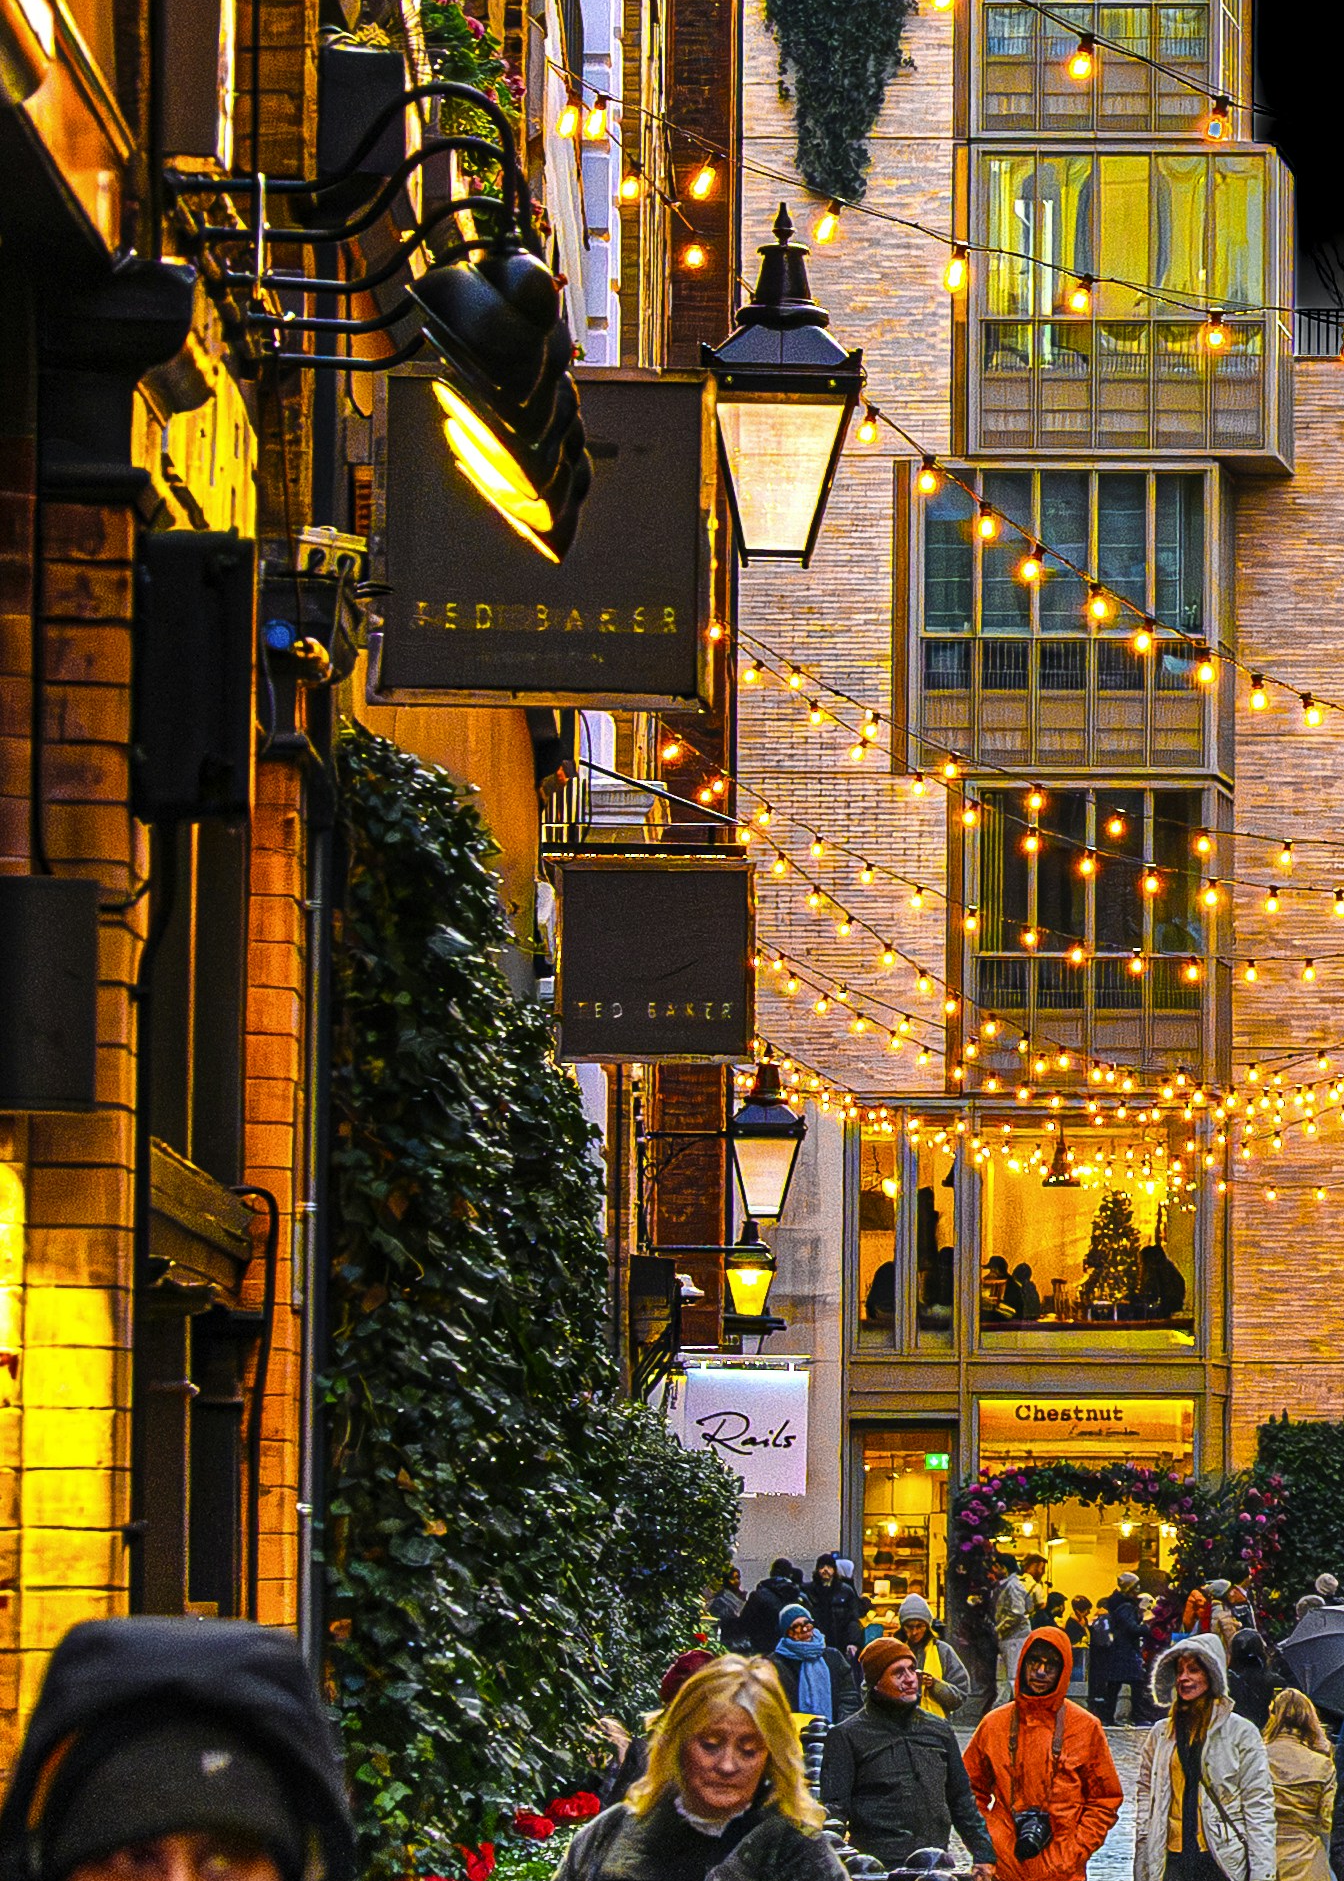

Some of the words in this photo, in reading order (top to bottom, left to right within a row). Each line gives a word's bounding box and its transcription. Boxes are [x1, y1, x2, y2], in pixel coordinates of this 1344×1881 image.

[412, 601, 493, 630] TED
[1015, 1404, 1124, 1422] Chestnut
[696, 1411, 797, 1456] Rails
